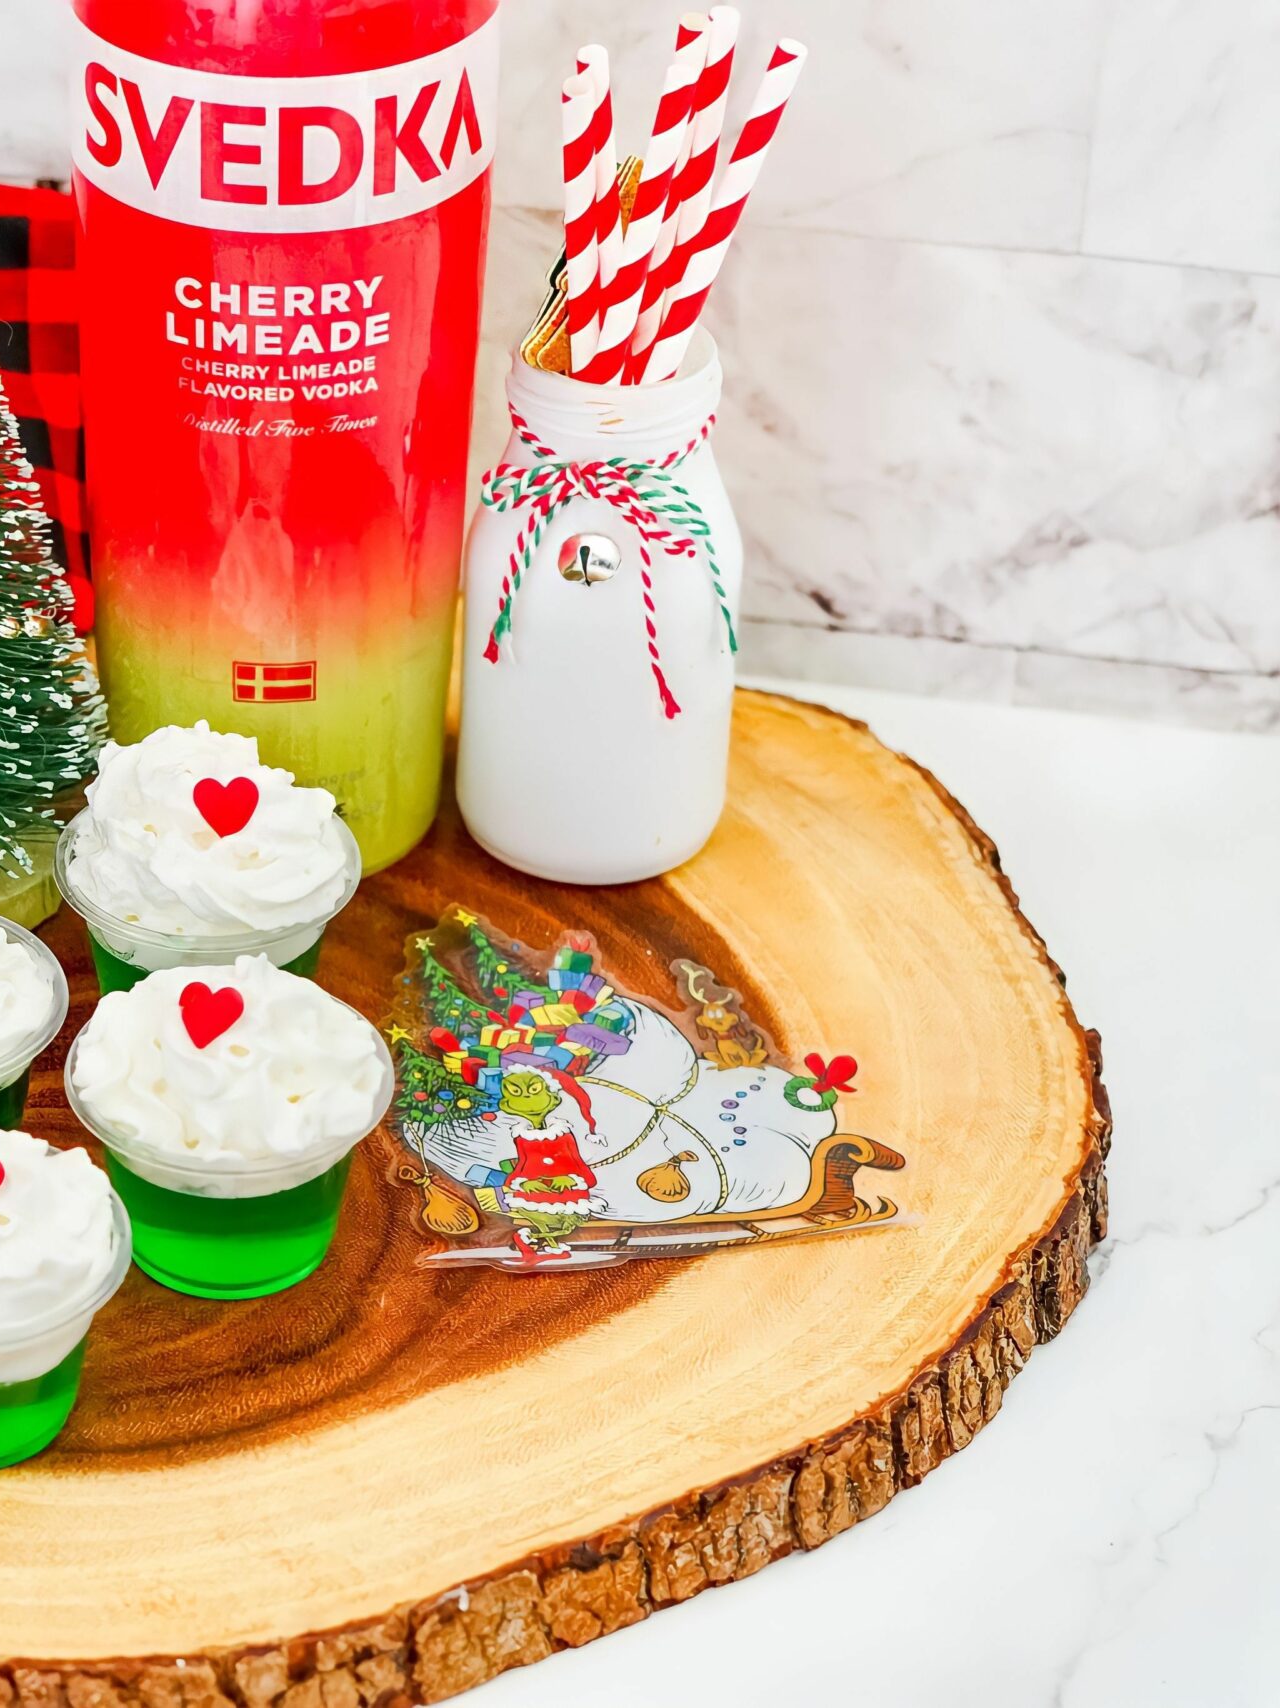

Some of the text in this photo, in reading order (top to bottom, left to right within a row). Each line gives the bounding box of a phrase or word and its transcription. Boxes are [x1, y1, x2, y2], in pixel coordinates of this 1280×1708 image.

[85, 61, 483, 206] SVEDKA
[174, 275, 384, 317] CHERRY
[166, 311, 390, 356] LIMEADE
[181, 355, 376, 381] CHERRY LIMEADE
[178, 376, 379, 402] FLAVORED VODKA
[321, 414, 378, 433] Times
